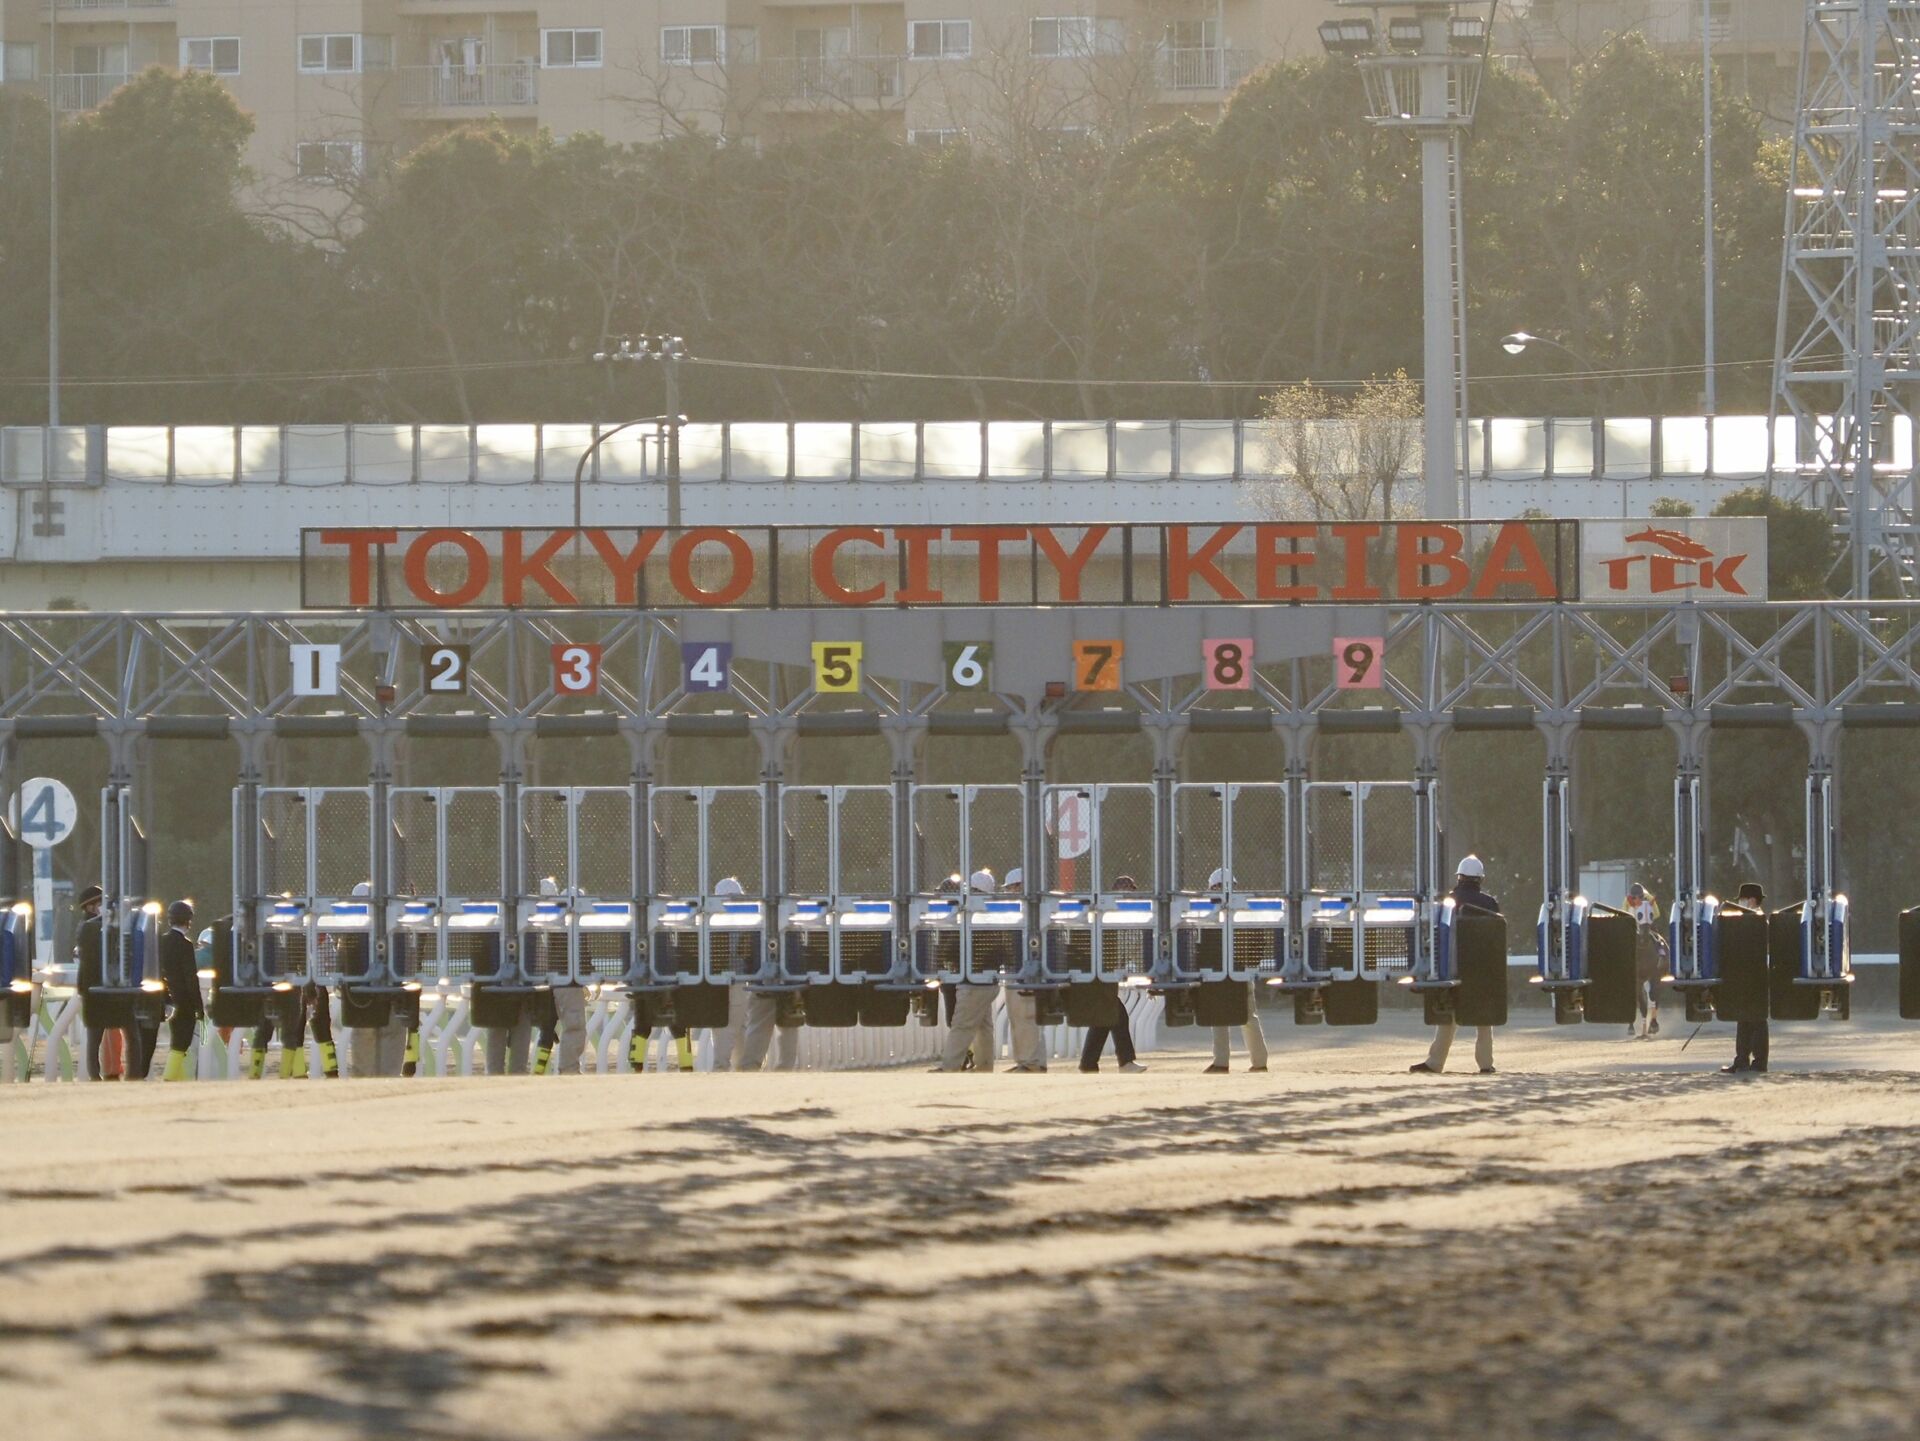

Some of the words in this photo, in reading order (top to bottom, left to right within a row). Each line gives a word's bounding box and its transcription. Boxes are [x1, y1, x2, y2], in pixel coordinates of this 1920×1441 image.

[321, 528, 754, 606] TOKYO
[810, 526, 1107, 603] CITY
[1167, 522, 1556, 601] KEIBA
[1599, 553, 1748, 596] TCK
[430, 650, 462, 690] 2
[560, 649, 592, 690] 3
[690, 648, 723, 687] 4
[822, 647, 853, 687] 5
[951, 646, 984, 686] 6
[1083, 646, 1113, 685] 7
[1214, 643, 1244, 685] 8
[1343, 643, 1374, 683] 9
[21, 785, 65, 841] 4
[1057, 795, 1088, 853] 4
